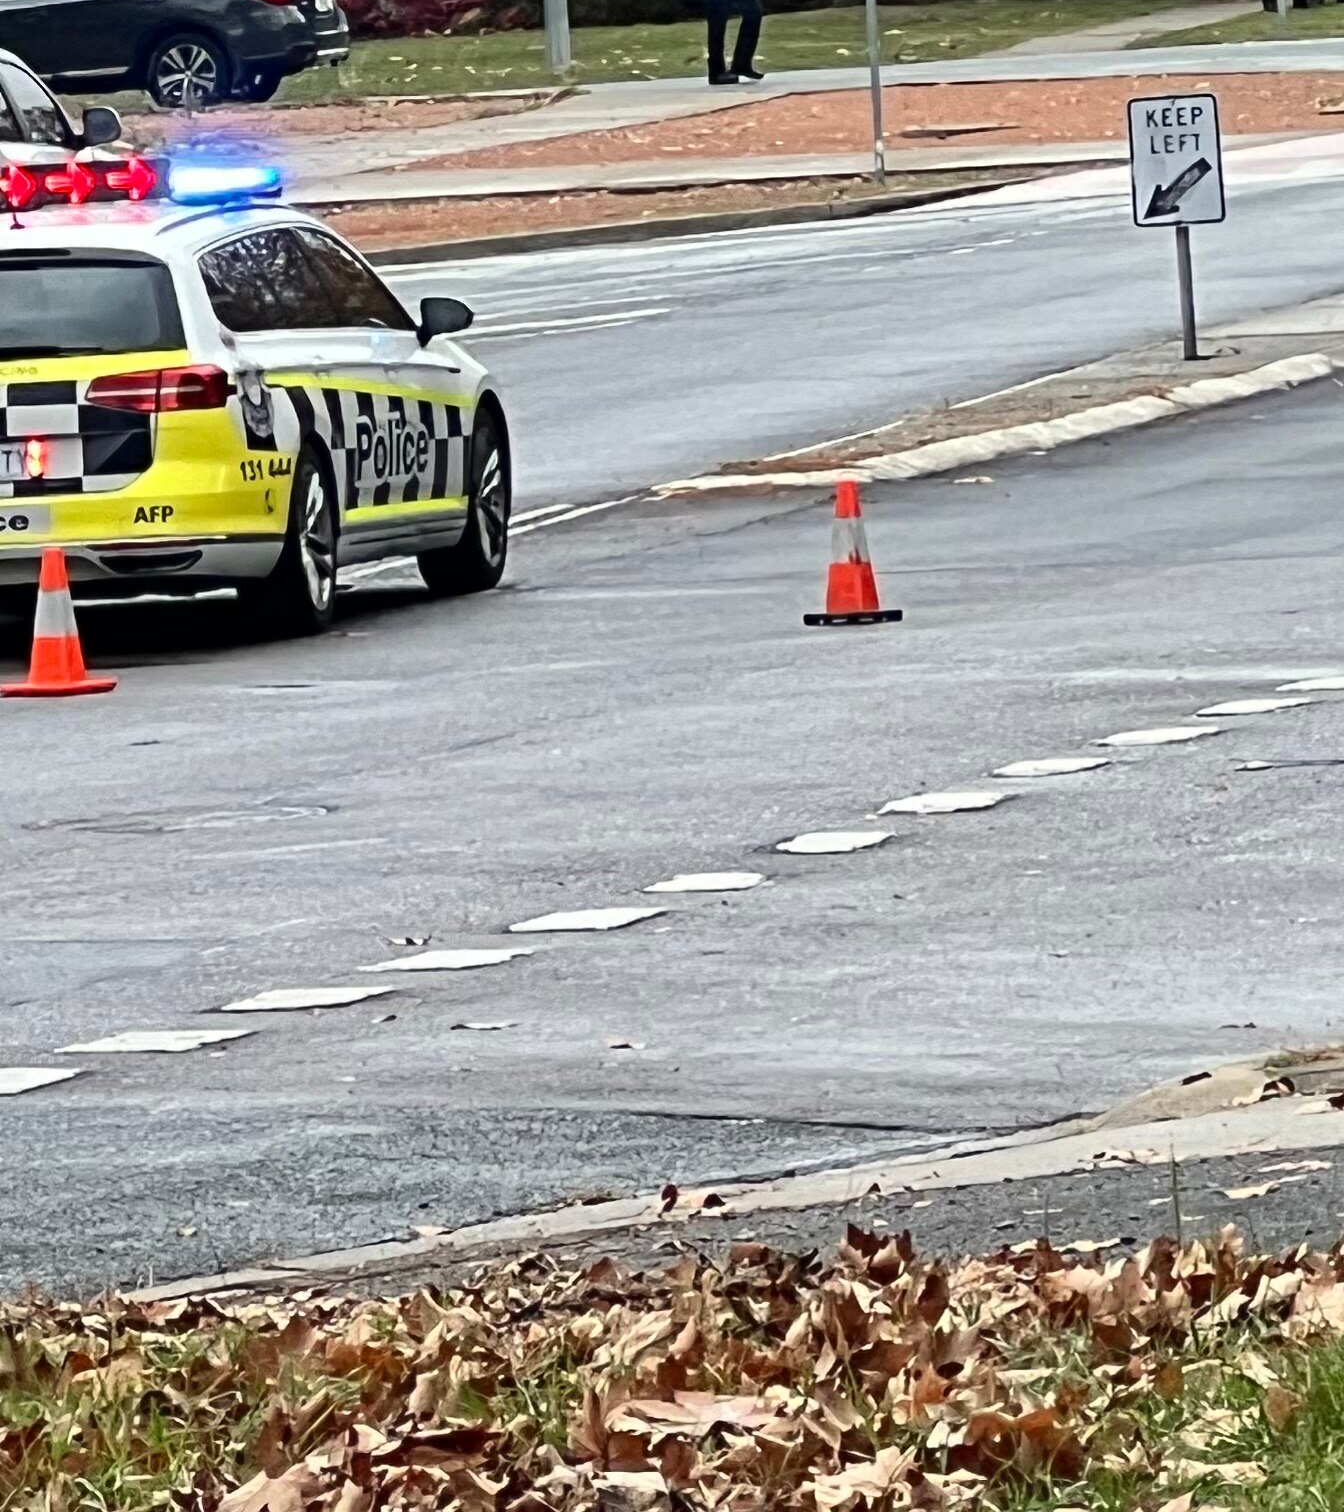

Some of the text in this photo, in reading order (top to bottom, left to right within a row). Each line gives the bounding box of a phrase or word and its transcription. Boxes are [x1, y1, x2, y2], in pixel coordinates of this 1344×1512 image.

[1146, 106, 1203, 127] KEEP
[1150, 134, 1200, 154] LEFT
[355, 418, 429, 481] Police
[240, 459, 264, 481] 131
[134, 506, 174, 524] AFP
